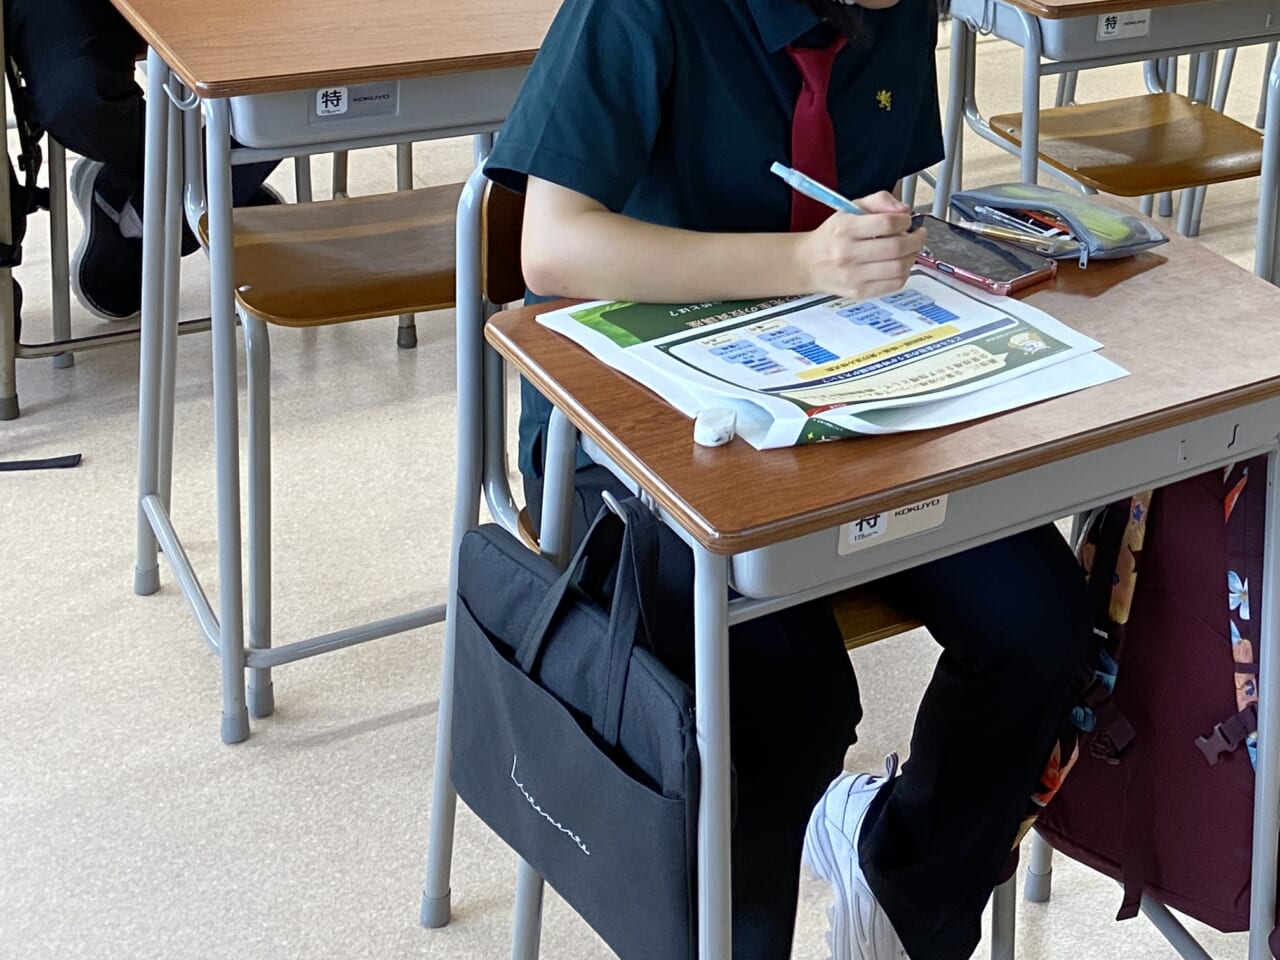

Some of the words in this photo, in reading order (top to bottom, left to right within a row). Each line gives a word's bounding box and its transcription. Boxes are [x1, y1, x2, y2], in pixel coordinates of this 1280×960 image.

[1104, 16, 1118, 30] 特
[321, 90, 342, 108] 特
[894, 499, 941, 517] KOKUYO
